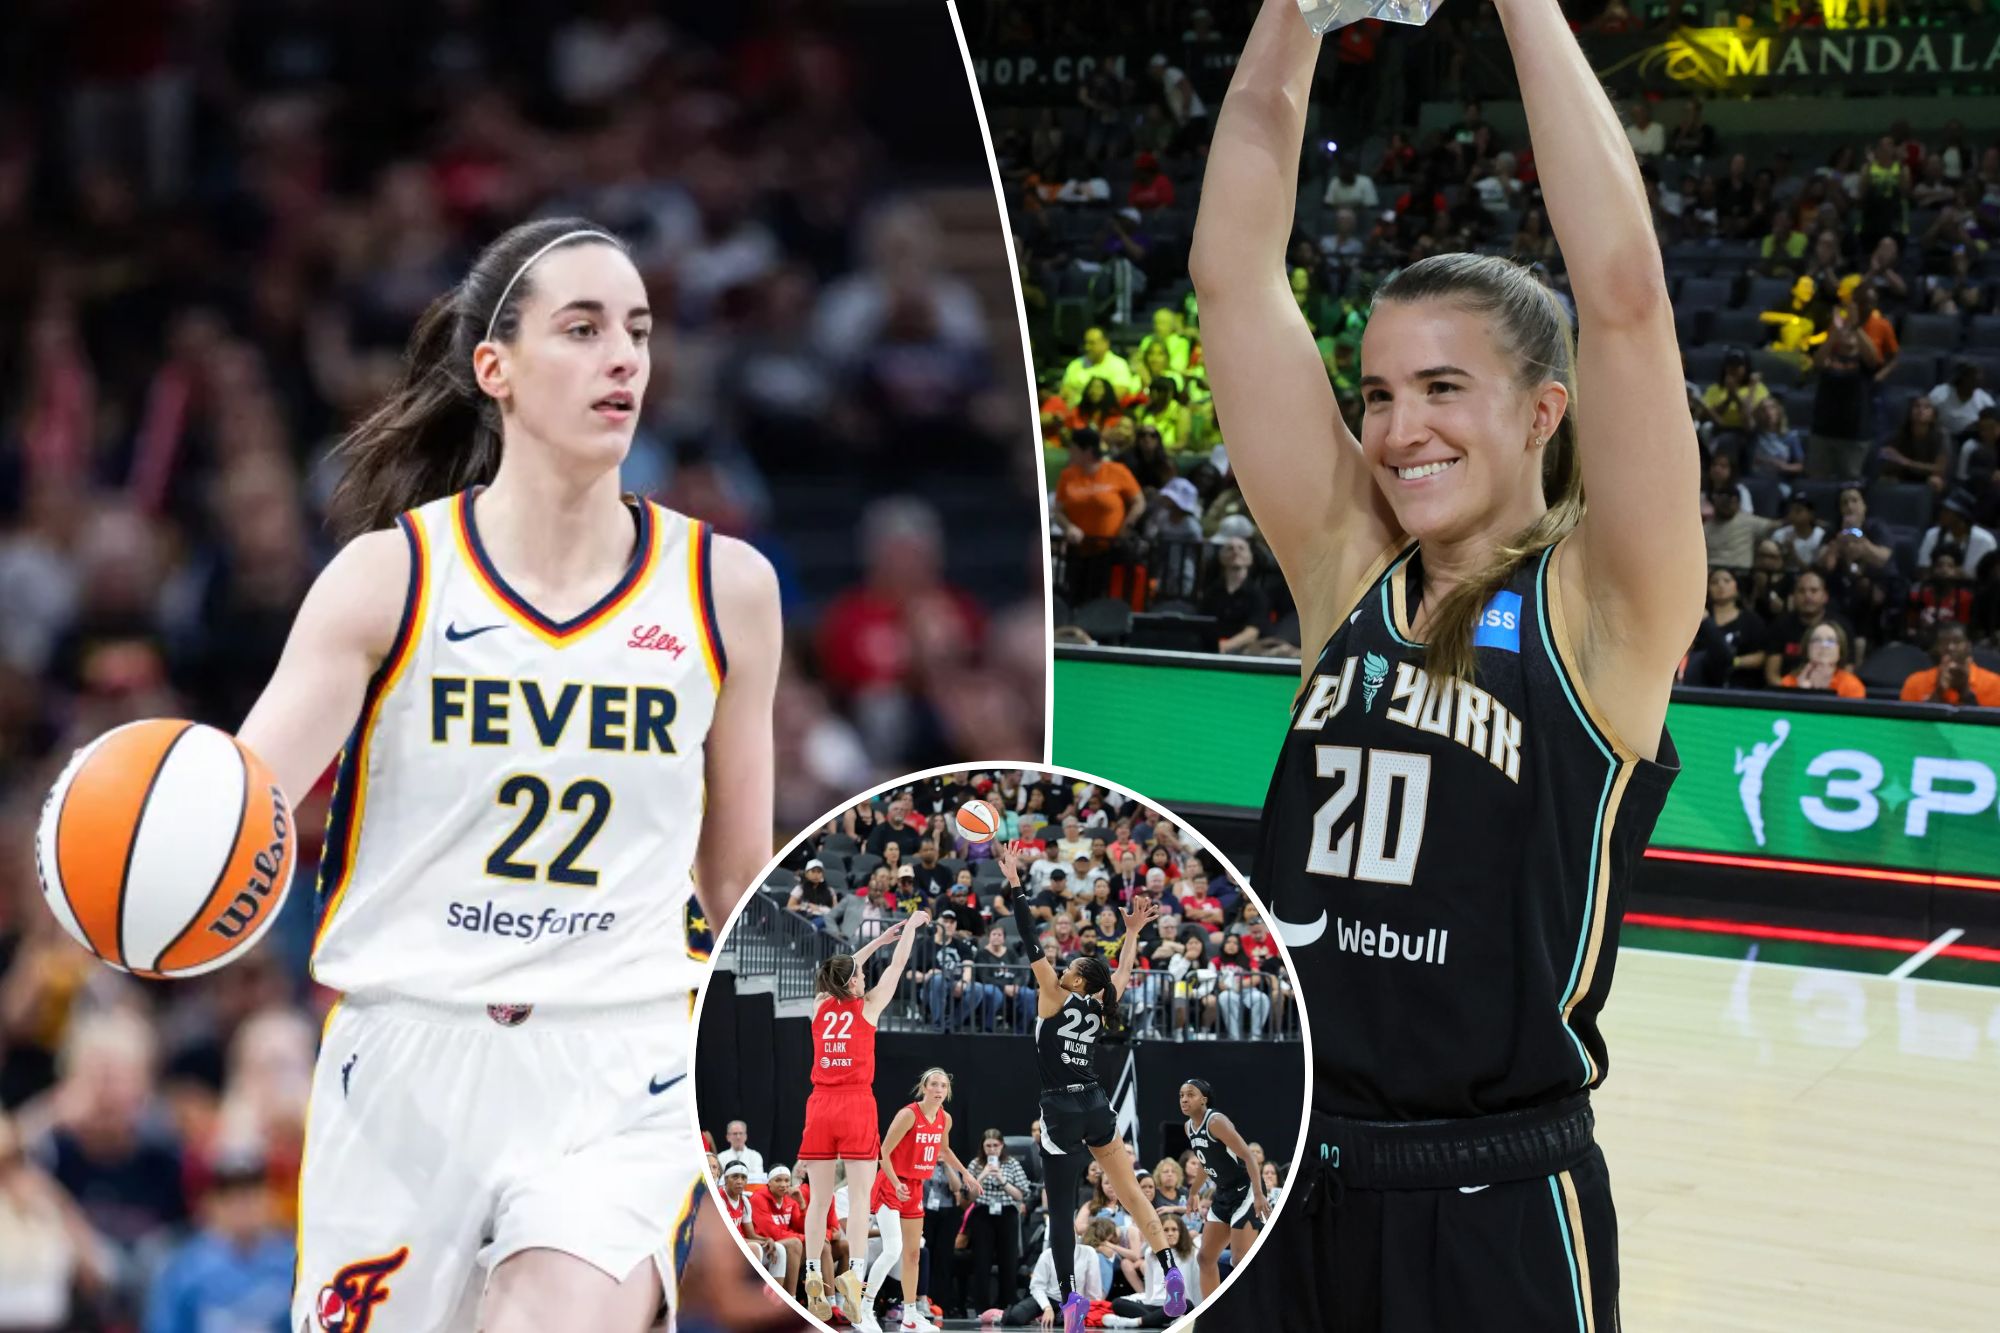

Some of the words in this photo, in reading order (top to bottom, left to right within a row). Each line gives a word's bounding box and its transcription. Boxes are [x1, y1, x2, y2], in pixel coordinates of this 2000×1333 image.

[627, 624, 688, 661] Lilly
[431, 675, 678, 754] FEVER
[1386, 660, 1523, 785] YORK
[1305, 744, 1432, 887] 20
[1904, 755, 2000, 838] P
[485, 773, 614, 888] 22
[208, 784, 289, 939] Wilson
[447, 901, 615, 944] salesforce
[1336, 916, 1449, 965] Webull
[822, 1011, 854, 1040] 22
[824, 1041, 847, 1053] CLARK
[1057, 1007, 1101, 1044] 22
[1064, 1039, 1088, 1055] WILSON
[831, 1057, 853, 1067] AT&T
[923, 1145, 935, 1162] 10
